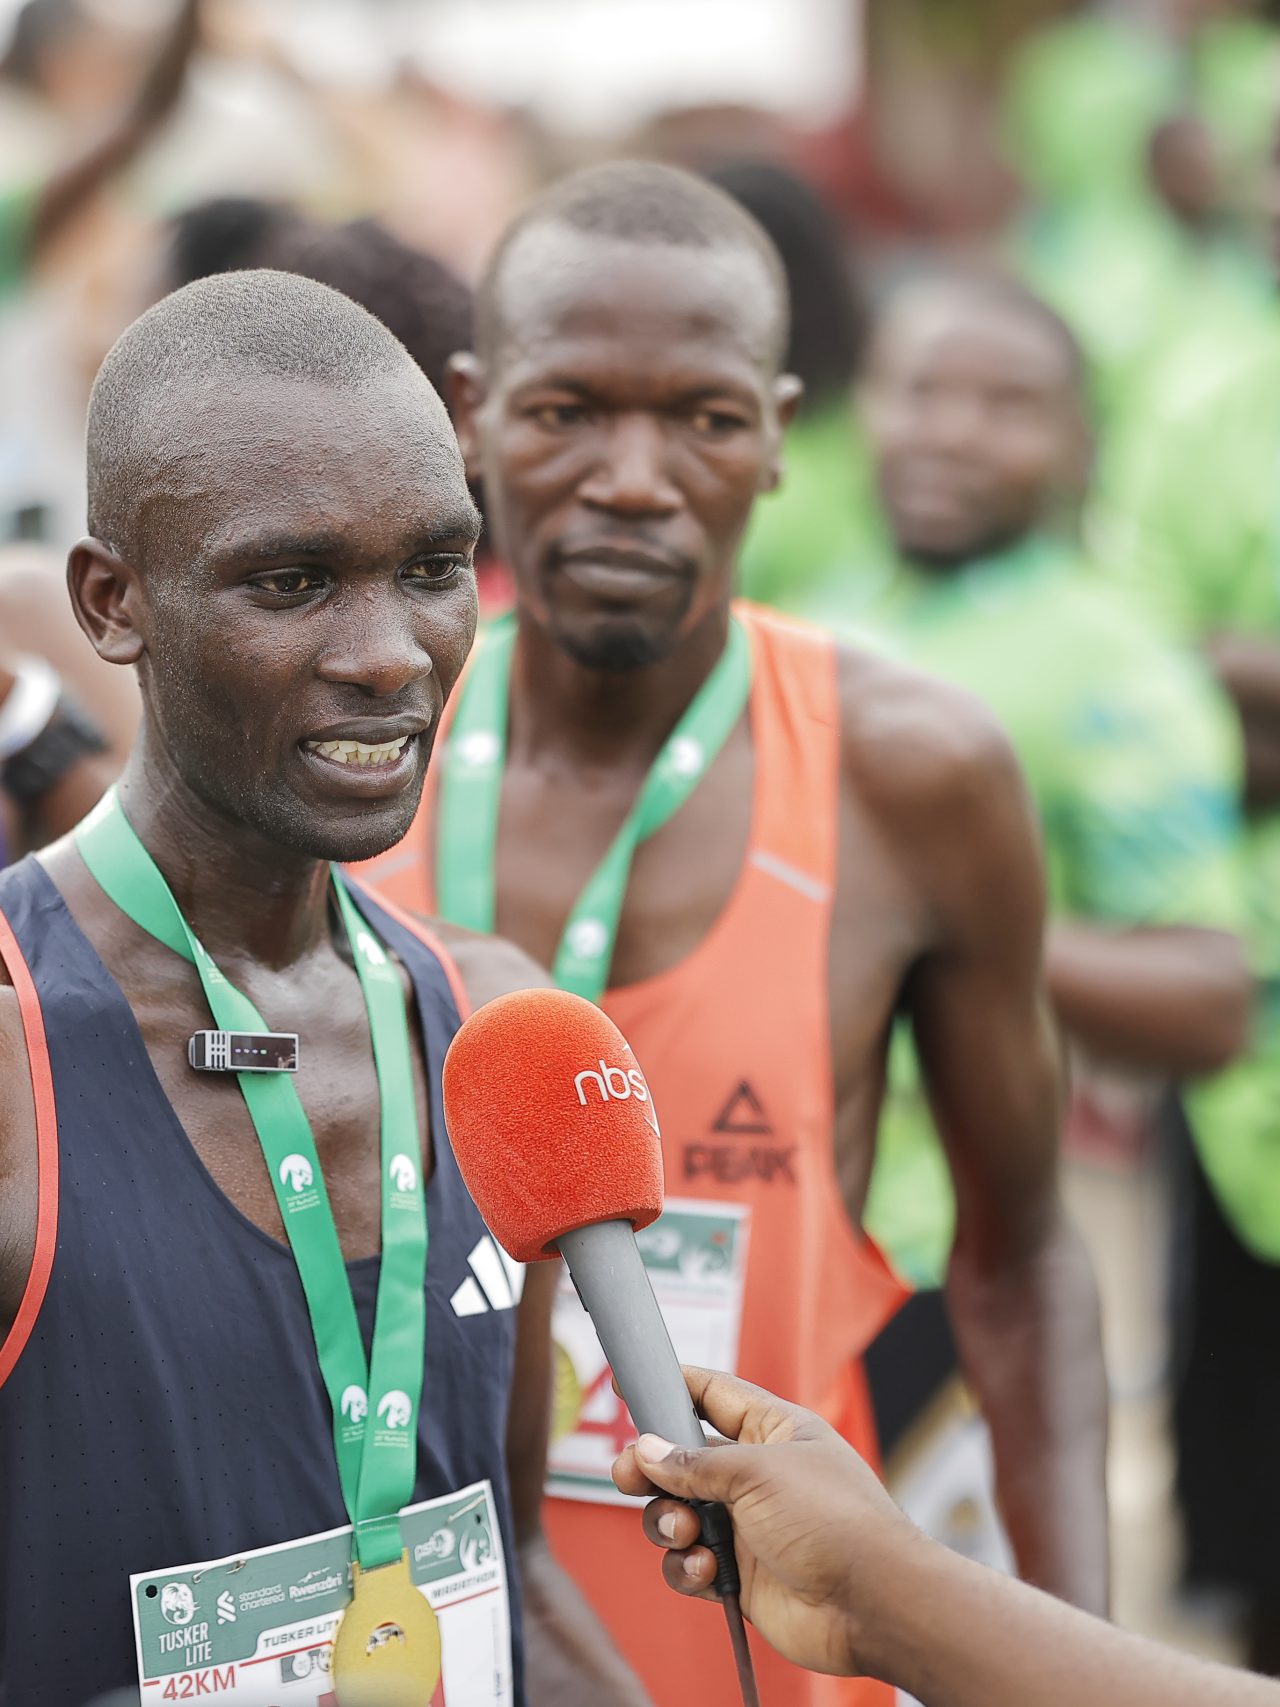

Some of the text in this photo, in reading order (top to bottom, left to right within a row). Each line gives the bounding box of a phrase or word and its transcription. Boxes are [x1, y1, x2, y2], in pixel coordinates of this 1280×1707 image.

[574, 1059, 648, 1106] nbs
[683, 1146, 797, 1183] PEAK
[238, 1583, 283, 1604] standard
[239, 1593, 286, 1612] chartered
[158, 1622, 209, 1653] TUSKER
[263, 1619, 340, 1649] TUSKER LIT
[185, 1641, 213, 1667] LITE
[162, 1665, 237, 1701] 42KM
